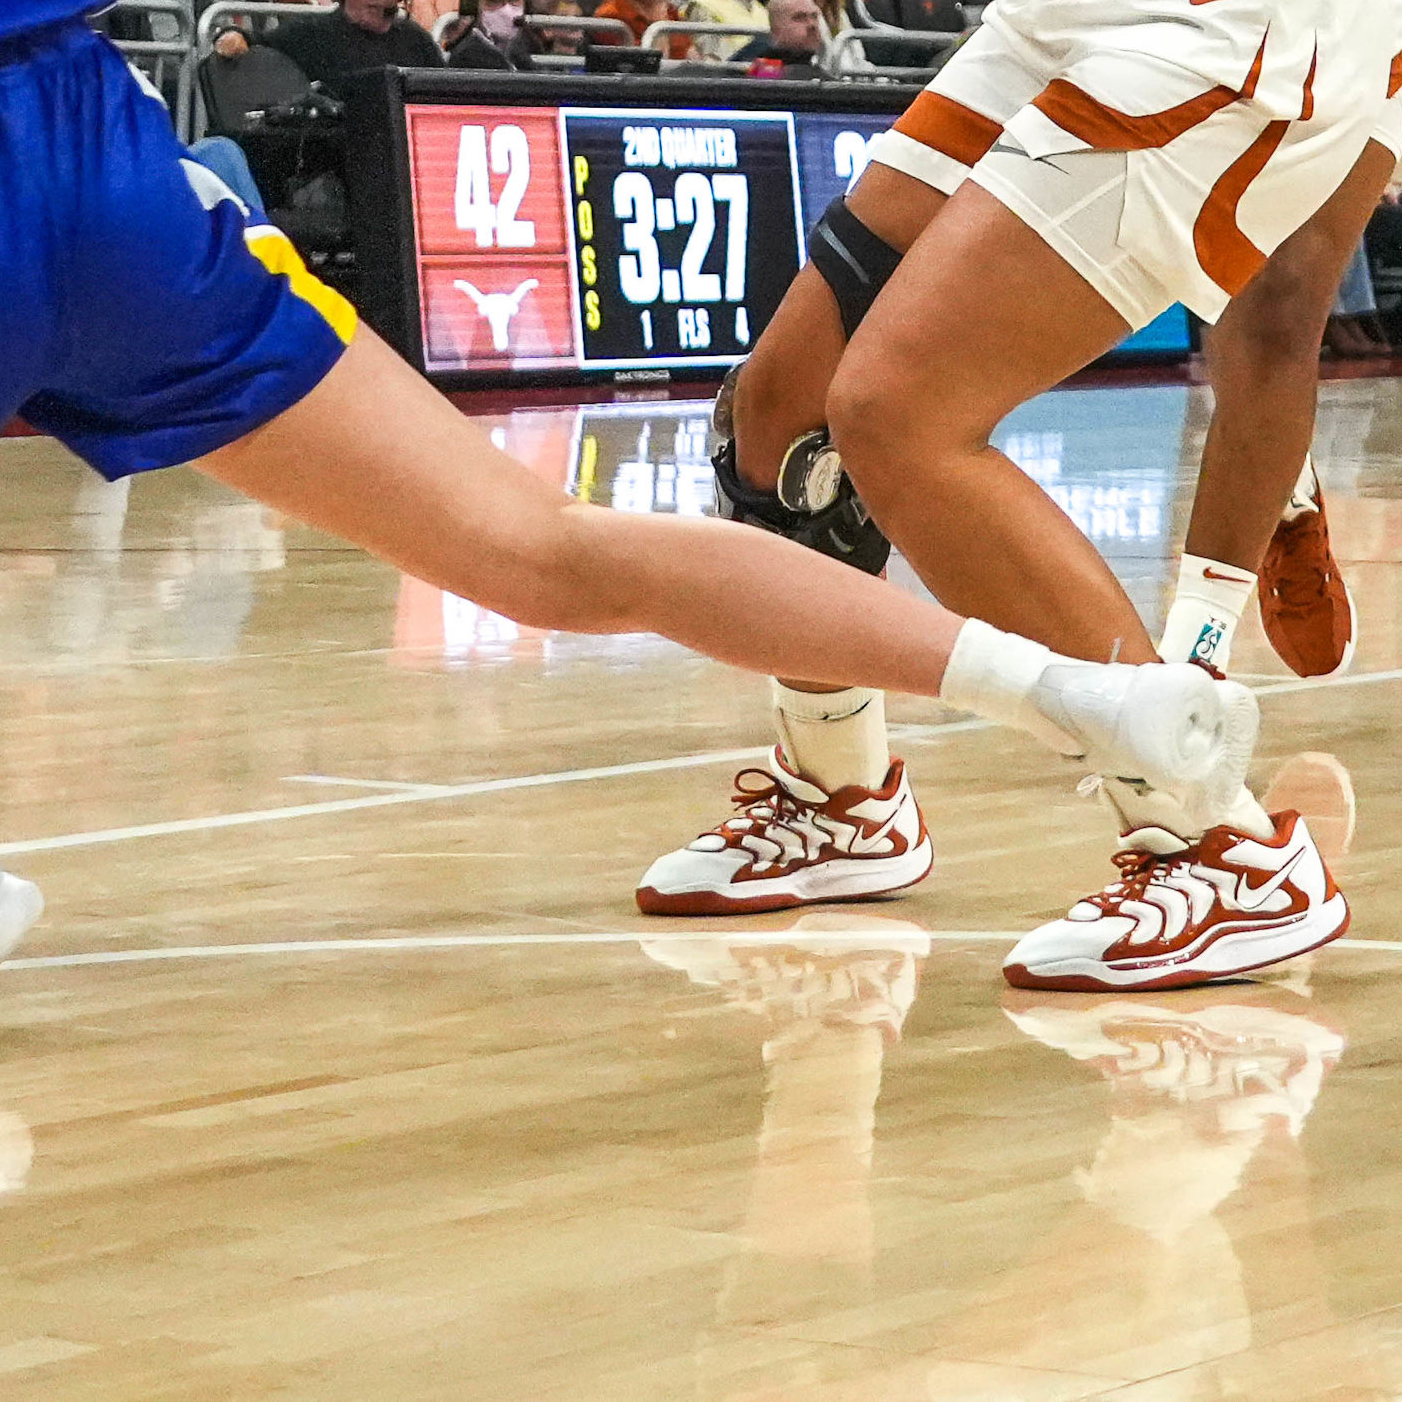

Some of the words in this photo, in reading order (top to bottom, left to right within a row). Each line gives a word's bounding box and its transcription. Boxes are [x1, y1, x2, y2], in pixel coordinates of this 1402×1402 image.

[454, 124, 536, 248] 42
[612, 171, 749, 304] 3:27
[640, 309, 654, 349] 1
[677, 307, 712, 349] FLS
